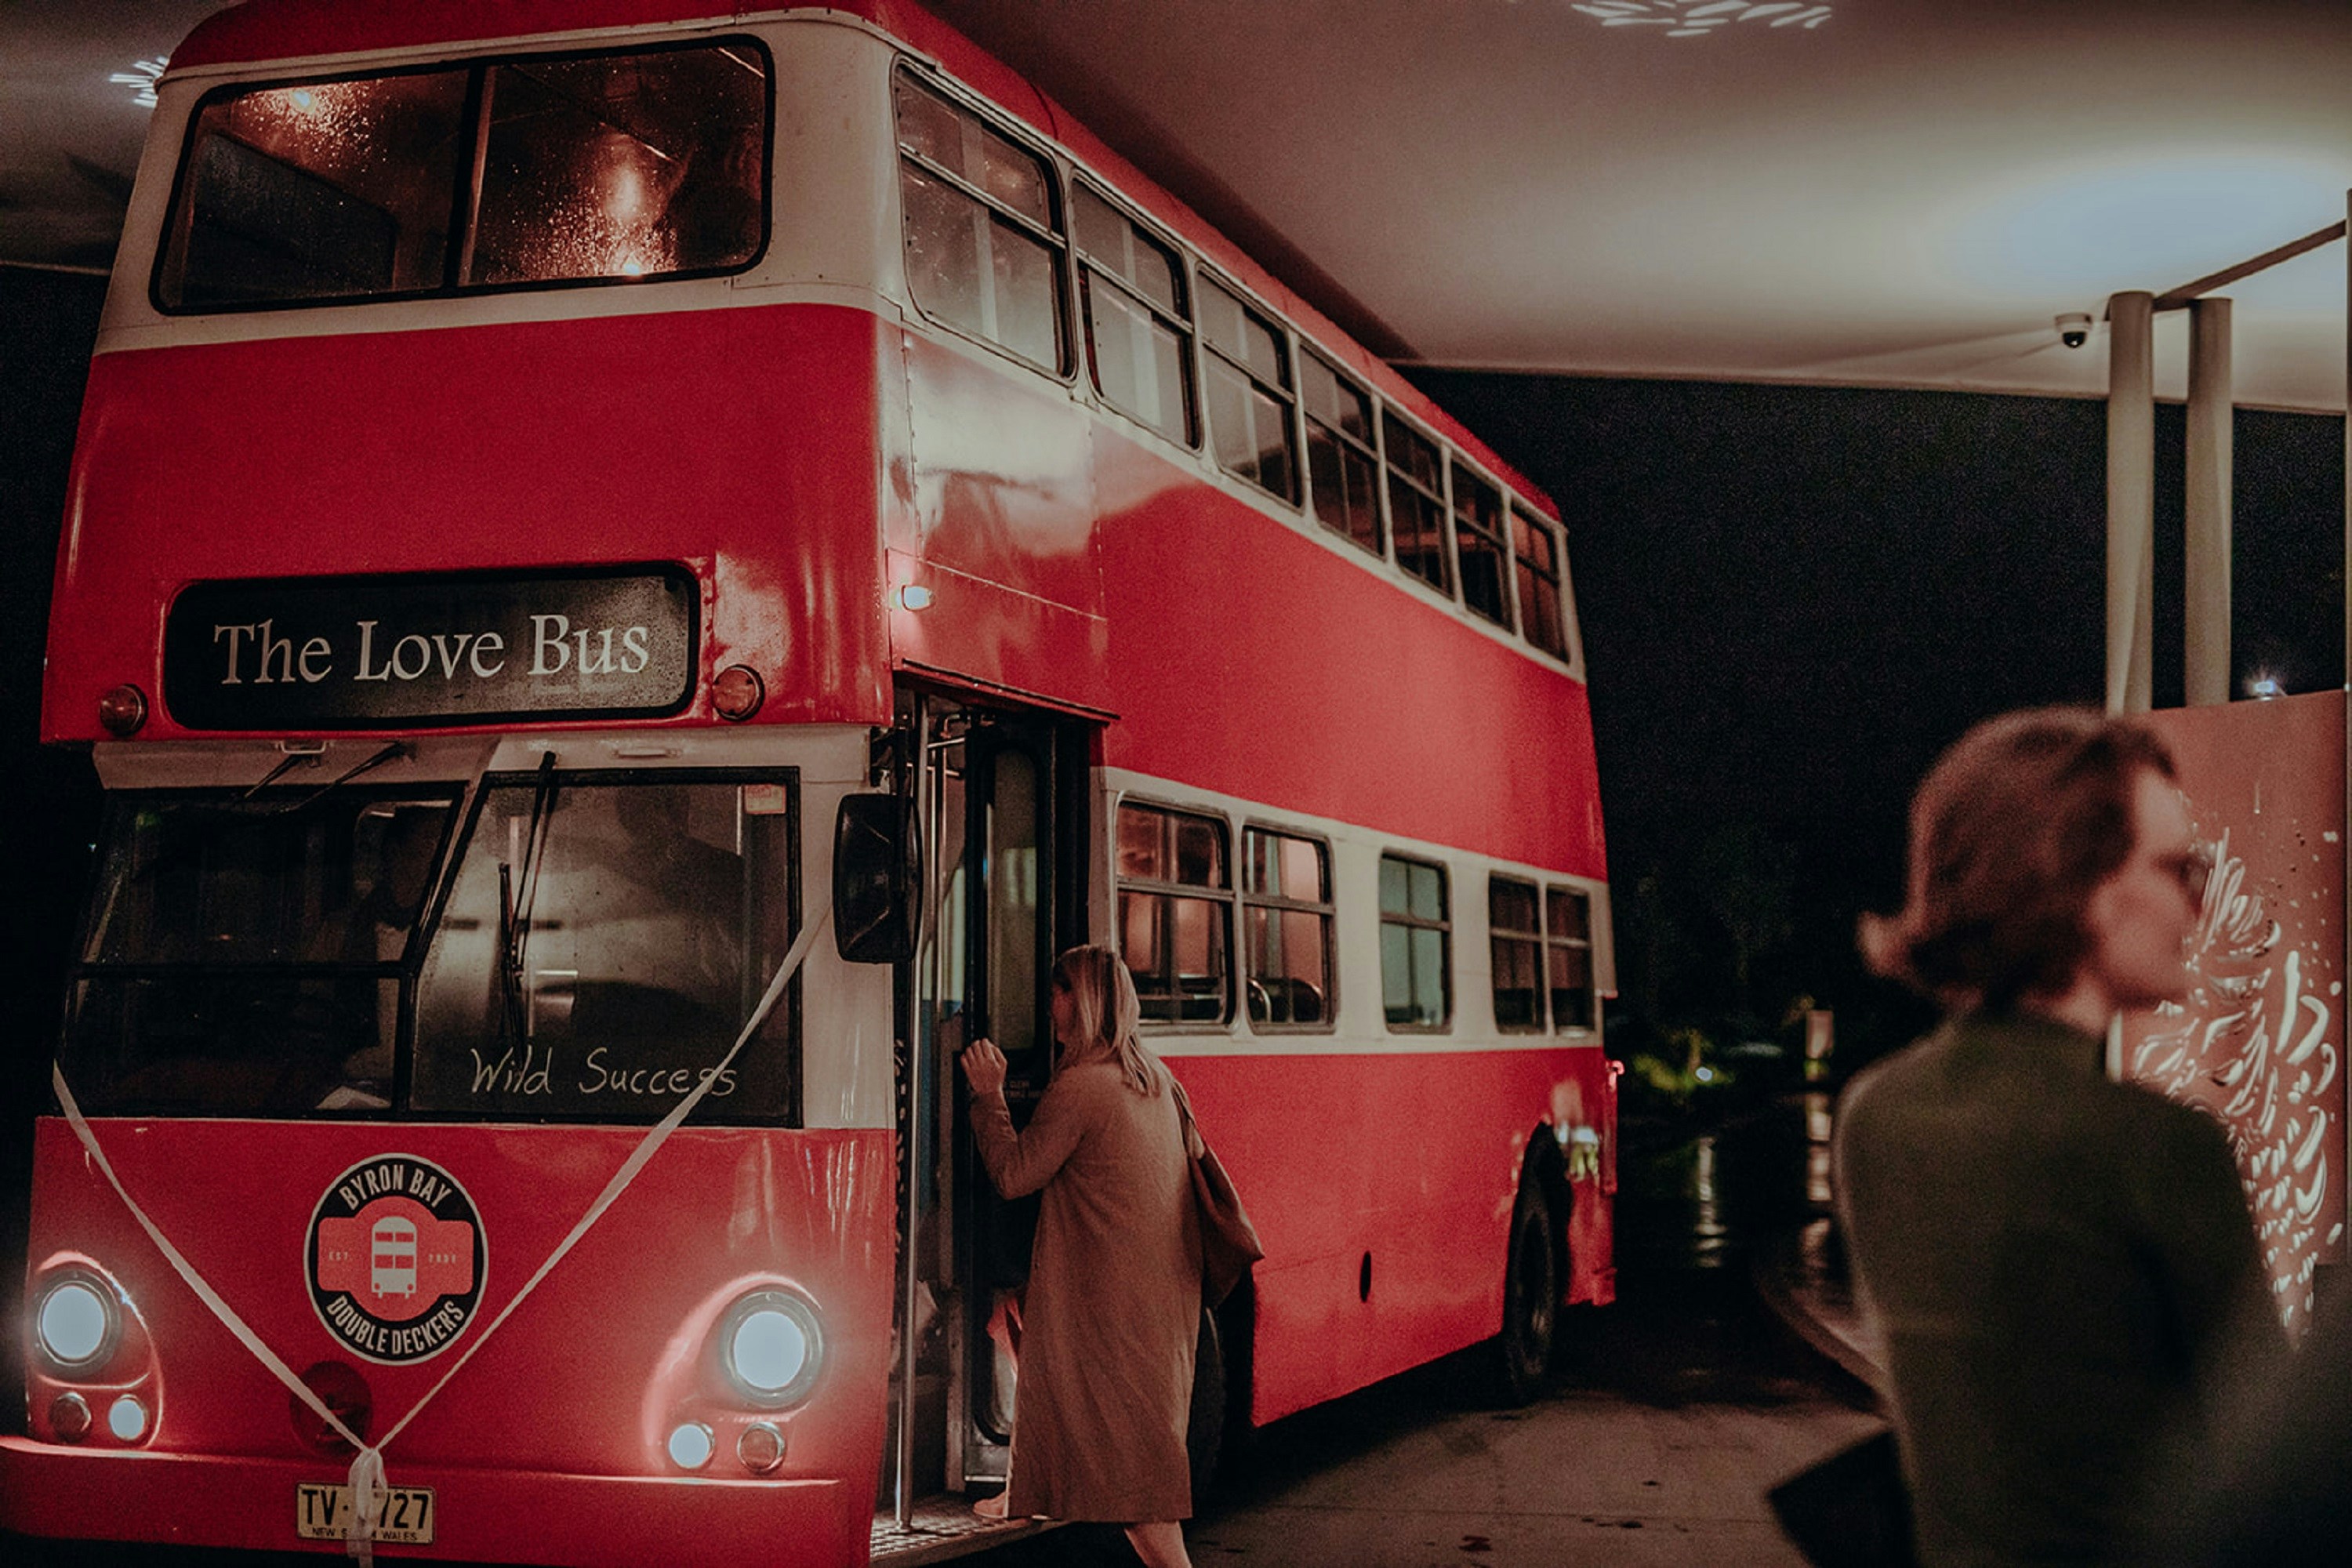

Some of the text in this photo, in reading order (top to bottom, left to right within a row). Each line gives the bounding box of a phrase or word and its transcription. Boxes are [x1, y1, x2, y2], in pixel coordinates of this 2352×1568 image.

[214, 614, 649, 685] The Love Bus
[470, 1044, 553, 1094] Wild
[339, 1164, 452, 1210] BYRON BAY
[326, 1294, 465, 1355] DOUBLE DECKERS
[383, 1530, 417, 1541] WALES
